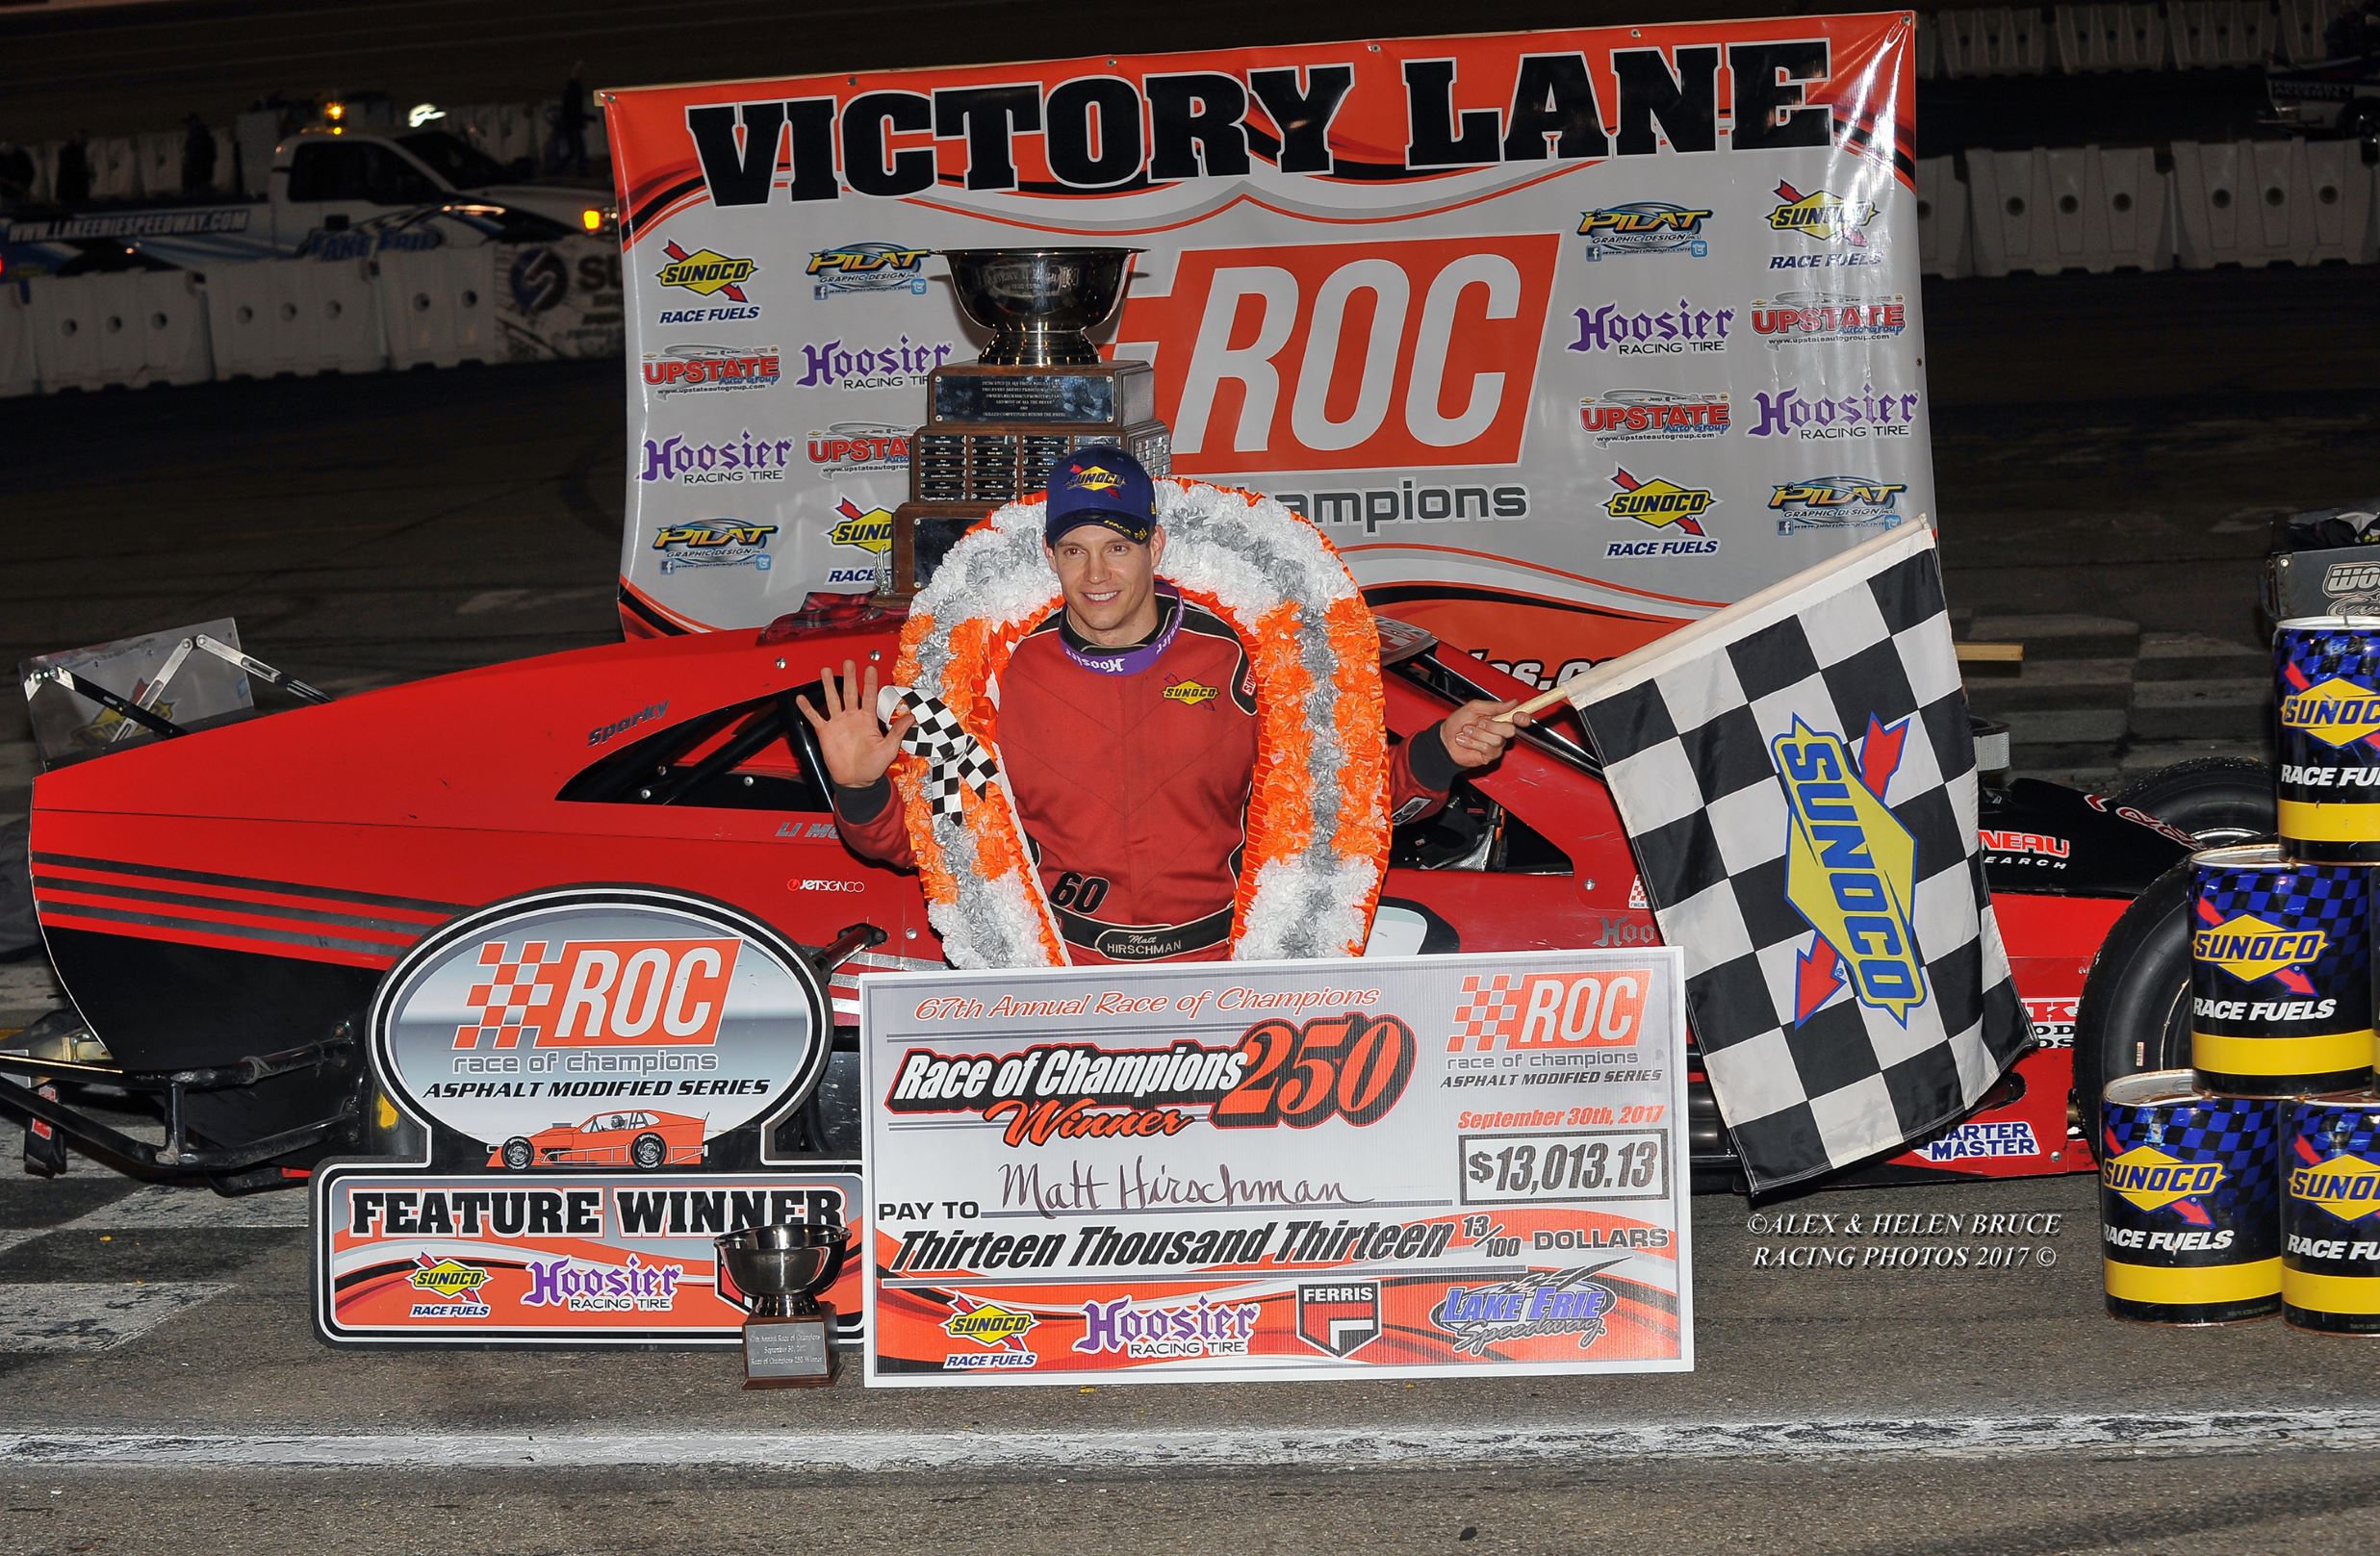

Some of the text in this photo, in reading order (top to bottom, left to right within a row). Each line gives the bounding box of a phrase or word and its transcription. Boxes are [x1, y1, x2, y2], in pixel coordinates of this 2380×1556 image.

[685, 38, 1832, 207] VICTORY LANE
[1576, 209, 1713, 236] PILAT
[1593, 235, 1642, 243] GRAPHIC
[663, 259, 749, 284] SUNOCO
[806, 249, 931, 275] PILAT
[1770, 255, 1822, 269] RACE
[820, 274, 866, 283] GRAPHIC
[659, 307, 759, 323] RACE FUELS
[1568, 298, 1733, 352] Hoosier
[1752, 304, 1906, 334] UPSTATE
[1838, 325, 1904, 336] Auto Group
[1171, 253, 1522, 453] ROC
[1619, 340, 1726, 355] RACING TIRE
[642, 356, 780, 384] UPSTATE
[796, 335, 951, 387] Hoosier
[657, 384, 765, 395] www.upstateautogroup.com
[719, 375, 779, 385] Auto Group
[843, 377, 904, 390] RACING
[1580, 403, 1730, 431] UPSTATE
[1748, 383, 1917, 436] Hoosier
[1596, 433, 1715, 442] www.upstateautogroup.com
[1663, 423, 1728, 434] Auto Group
[1801, 424, 1908, 440] RACING TIRE
[636, 431, 792, 480] Hoosier
[807, 436, 910, 463] UPSTA
[683, 470, 782, 484] RACING TIRE
[1066, 472, 1125, 489] SUNOCO
[1274, 480, 1527, 533] ampions
[1613, 493, 1708, 513] SUNOCO
[1768, 484, 1907, 509] PILAT
[1784, 509, 1834, 518] GRAPHIC
[653, 525, 778, 549] PILAT
[836, 522, 892, 542] SUNO
[1607, 541, 1717, 556] RACE FUELS
[1065, 648, 1125, 673] Hoosier
[1164, 687, 1216, 699] SUNOCO
[587, 699, 670, 747] Sparky
[2284, 699, 2380, 725] SUNOC
[2281, 764, 2338, 786] RACE
[775, 822, 803, 837] LI
[1979, 830, 2070, 858] NEAU
[1780, 743, 1916, 999] SUNOCO
[1983, 855, 2067, 870] EARCH
[1051, 871, 1110, 914] 60
[1107, 940, 1182, 955] HIRSCHMAN
[1128, 935, 1157, 944] Matt
[2195, 933, 2320, 960] SUNOCO
[553, 947, 723, 1038] ROC
[914, 986, 1382, 1022] 67th Annual Race of Champions
[1520, 977, 1637, 1043] ROC
[2193, 997, 2338, 1021] RACE FUELS
[452, 1049, 719, 1078] race of champions
[893, 1015, 1409, 1119] Race of Champions 250
[1447, 1051, 1639, 1070] race of champions
[422, 1078, 771, 1099] ASPHALT MODIFIED SERIES
[1440, 1069, 1663, 1088] ASPHALT MODIFIED SERIES
[985, 1098, 1195, 1147] Winner
[1457, 1105, 1665, 1131] September 30th, 2017
[1942, 1122, 2031, 1141] ARTER
[1931, 1137, 2037, 1161] MASTER
[1468, 1140, 1658, 1195] $13,013.13
[2104, 1161, 2218, 1191] SUNOCO
[998, 1156, 1374, 1219] Matt Hirschman
[2292, 1173, 2380, 1200] SUNO
[349, 1187, 848, 1237] FEATURE WINNER
[879, 1200, 980, 1221] PAY TO
[890, 1230, 1066, 1271] Thirteen
[1068, 1222, 1278, 1267] Thousand
[1272, 1219, 1455, 1263] Thirteen
[1534, 1228, 1669, 1251] DOLLARS
[2104, 1224, 2235, 1251] RACE FUELS
[2288, 1234, 2348, 1260] RACE
[416, 1270, 484, 1287] SUNOCO
[521, 1254, 678, 1306] Hoosier
[570, 1297, 672, 1311] RACING TIRE
[1303, 1287, 1373, 1303] FERRIS
[1441, 1287, 1607, 1321] LAKE ERIE
[410, 1305, 490, 1317] RACE FUELS
[1074, 1294, 1255, 1352] Hoosier
[953, 1315, 1028, 1334] SUNOCO
[1454, 1317, 1606, 1352] Speedway
[947, 1353, 1036, 1367] RACE FUELS
[1130, 1340, 1245, 1355] RACING TIRE
